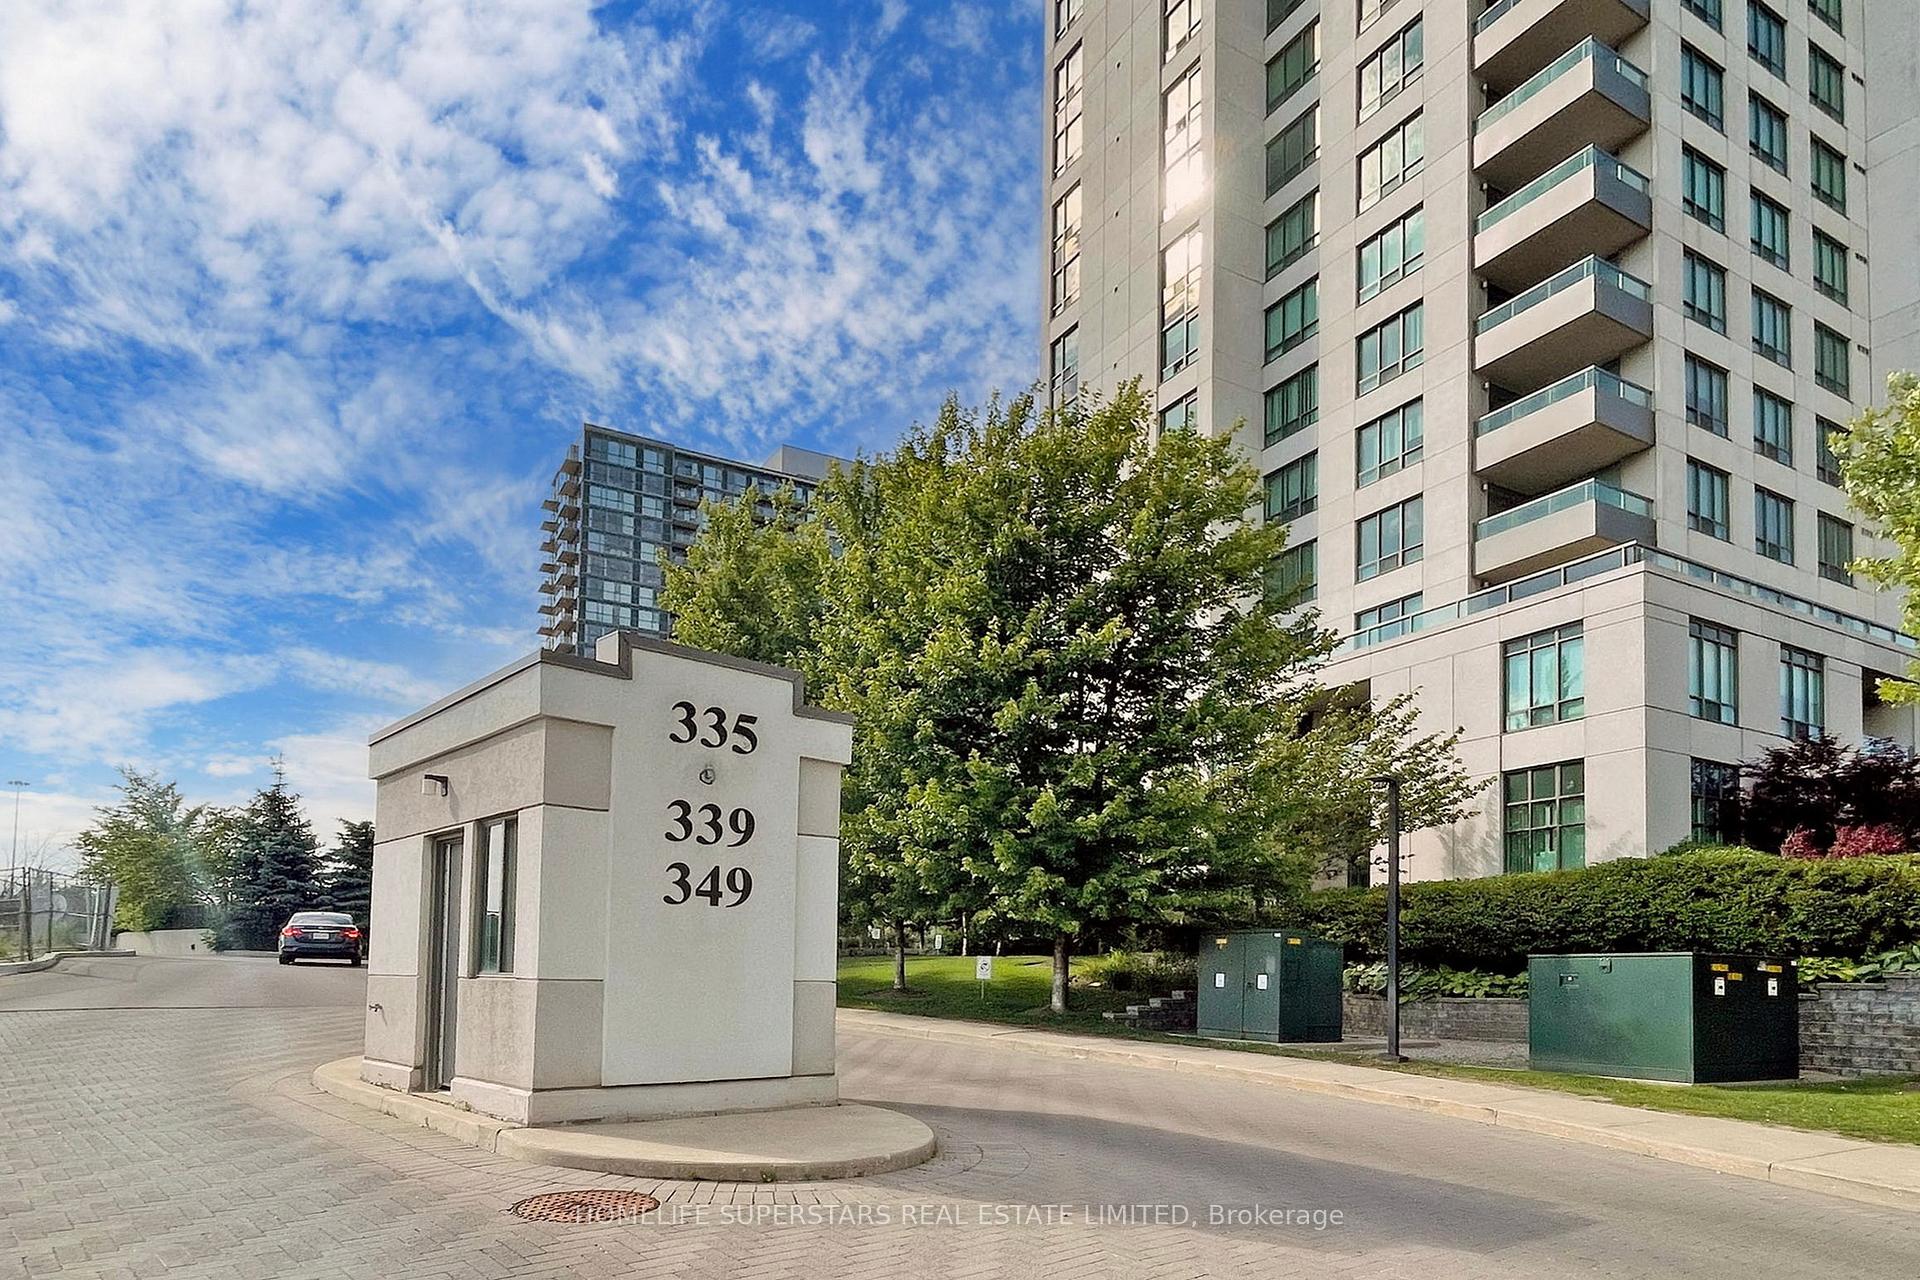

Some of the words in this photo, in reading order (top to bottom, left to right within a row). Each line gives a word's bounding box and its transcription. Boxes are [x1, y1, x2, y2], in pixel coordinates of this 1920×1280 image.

[669, 701, 758, 754] 335
[665, 799, 755, 847] 339
[663, 862, 753, 908] 349
